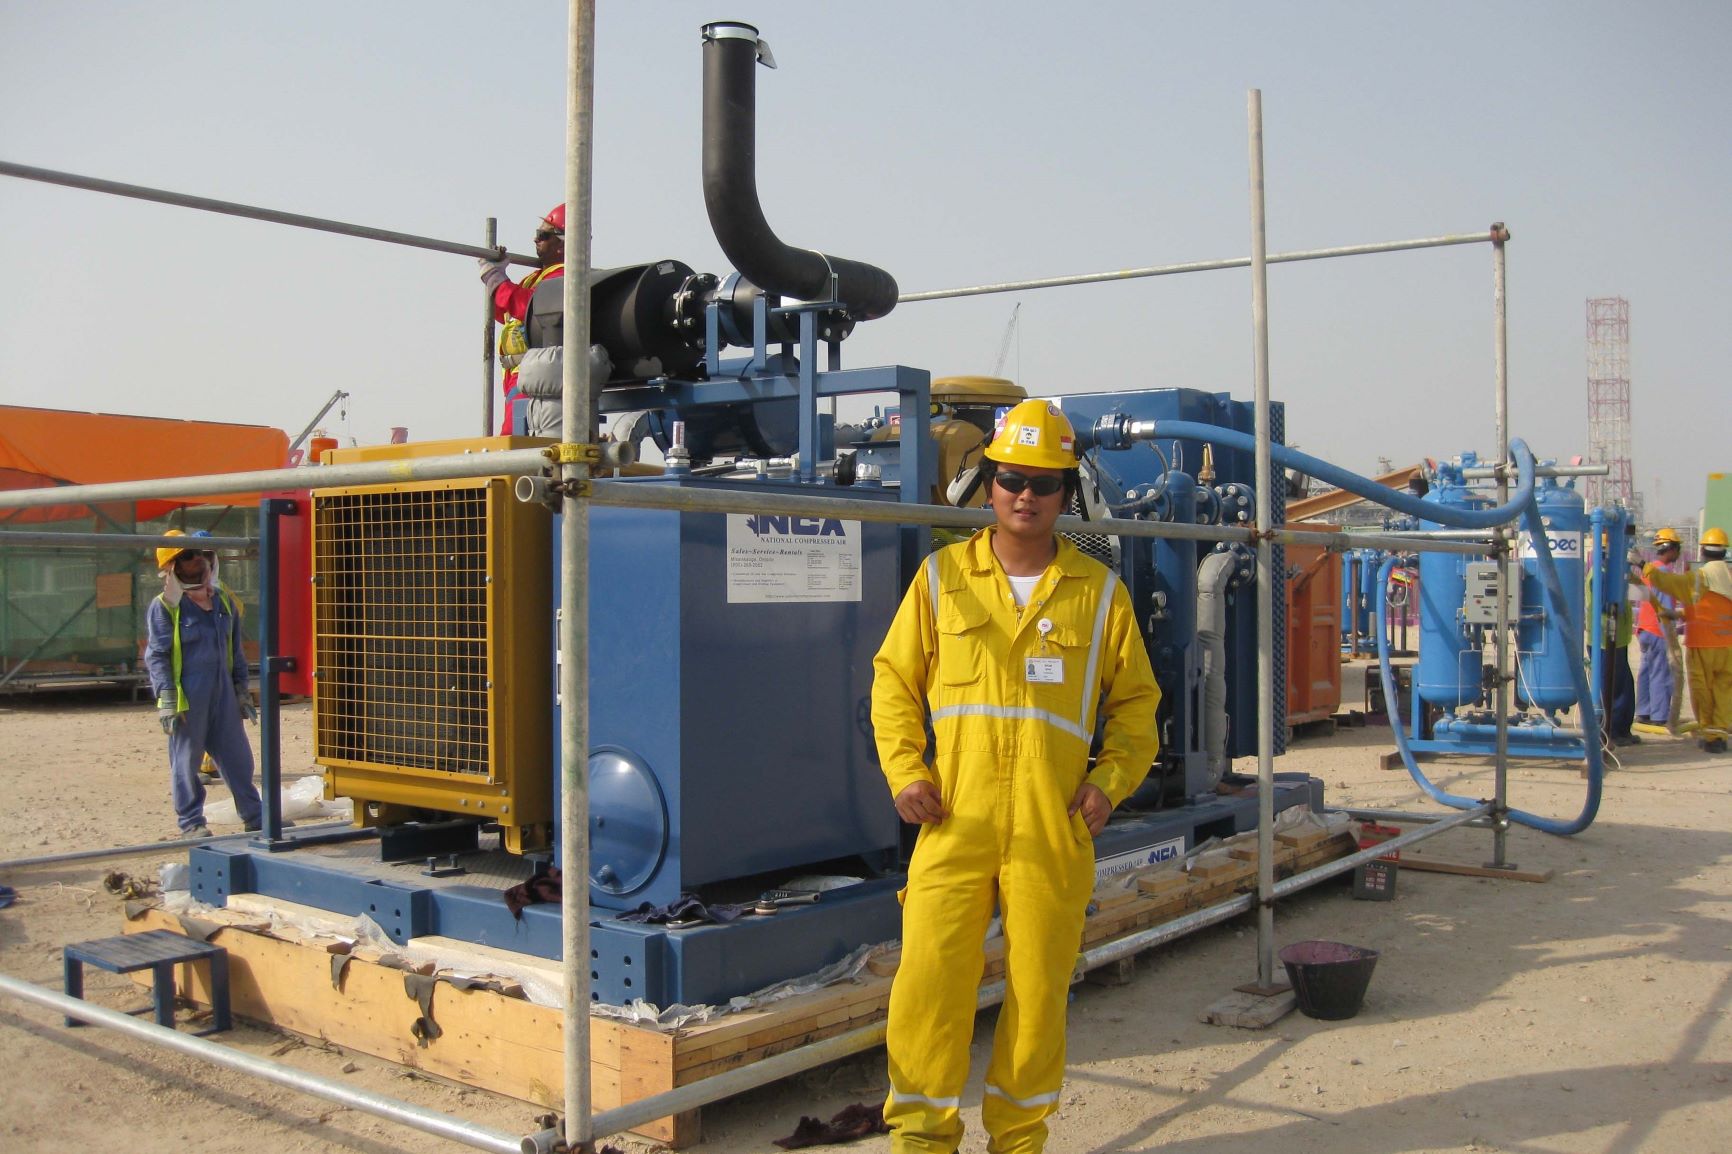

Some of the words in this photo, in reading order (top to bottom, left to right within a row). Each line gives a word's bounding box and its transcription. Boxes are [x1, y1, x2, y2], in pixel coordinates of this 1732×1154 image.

[759, 514, 846, 536] NCA
[760, 536, 793, 544] NATIONAL
[794, 537, 835, 545] COMPRESSED
[1527, 536, 1577, 551] xbec
[1149, 846, 1177, 864] NCA
